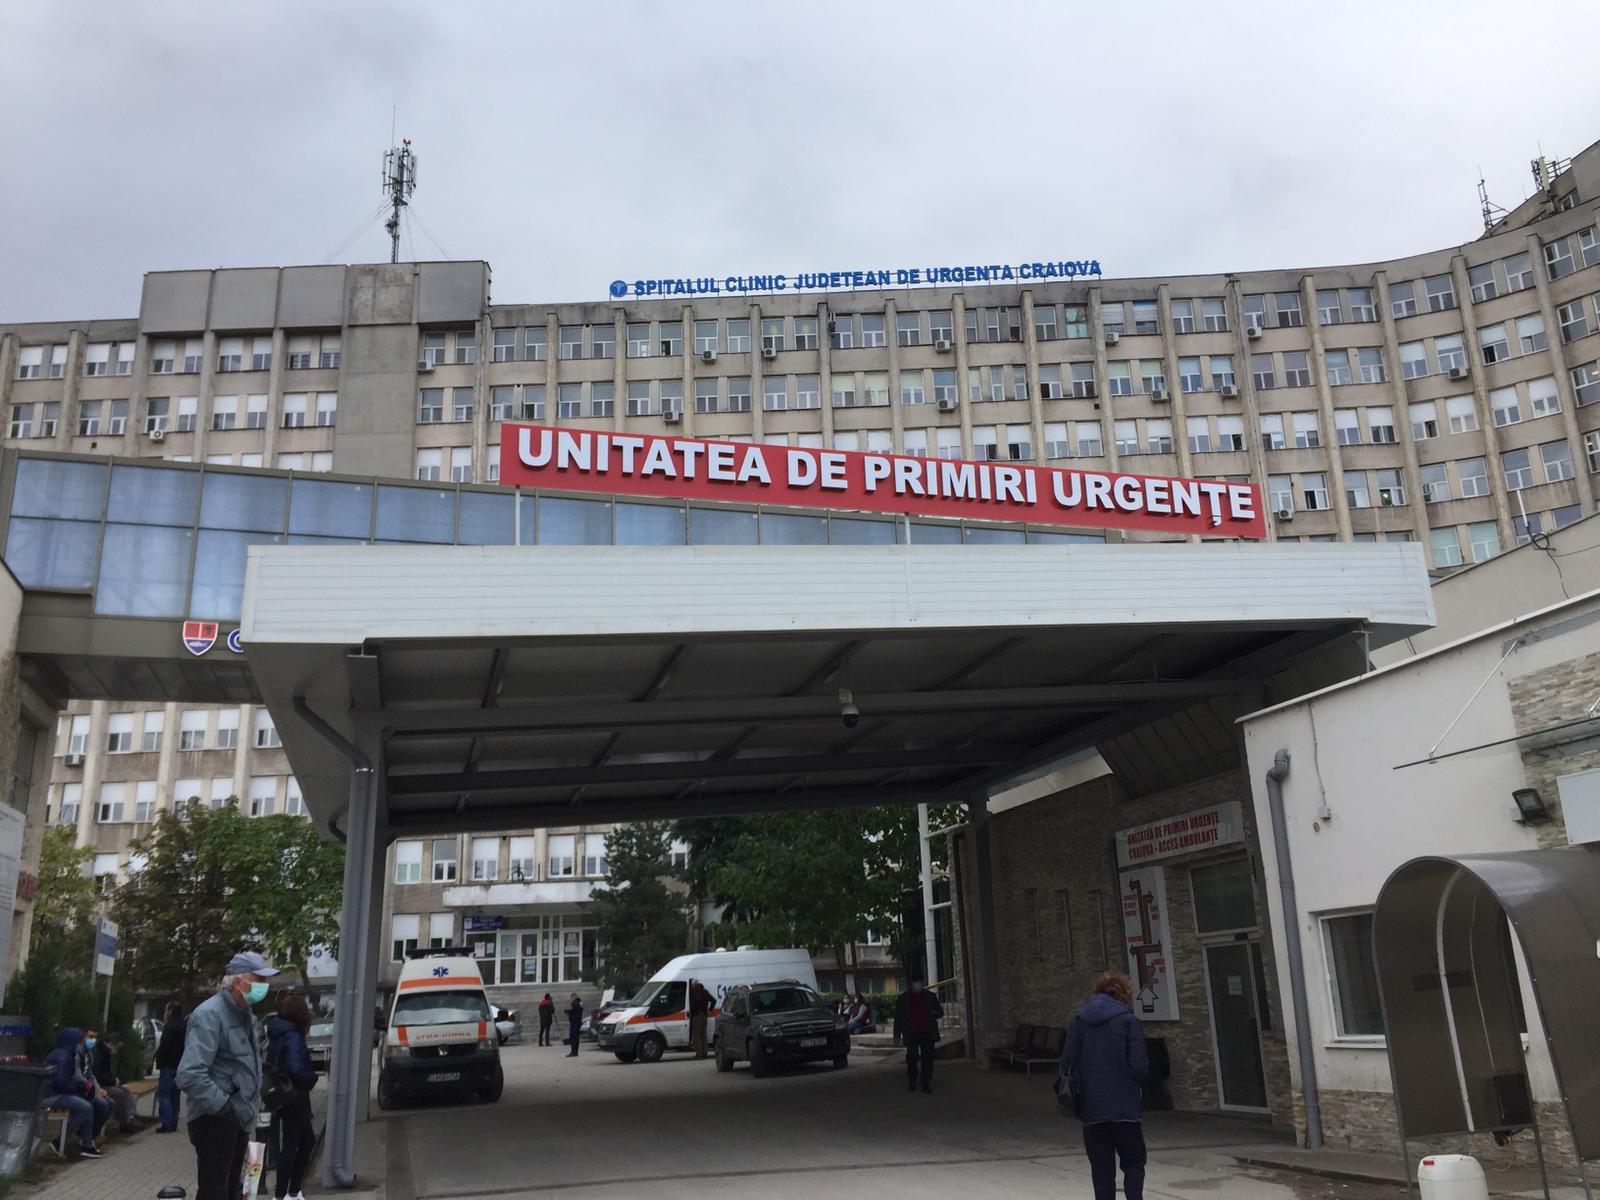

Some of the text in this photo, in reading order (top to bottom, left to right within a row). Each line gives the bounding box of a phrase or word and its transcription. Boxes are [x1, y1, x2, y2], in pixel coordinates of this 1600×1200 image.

[634, 260, 1102, 296] SPITALUL CLINIC JUDETEAN DE URGENTA CRAIOVA
[516, 427, 1257, 527] UNITATEA DE PRIMIRI URGENȚE
[1127, 829, 1154, 846] UNITATEA
[1154, 827, 1163, 839] DE
[1163, 819, 1189, 836] PRIMIRI
[1158, 837, 1179, 853] ACCES
